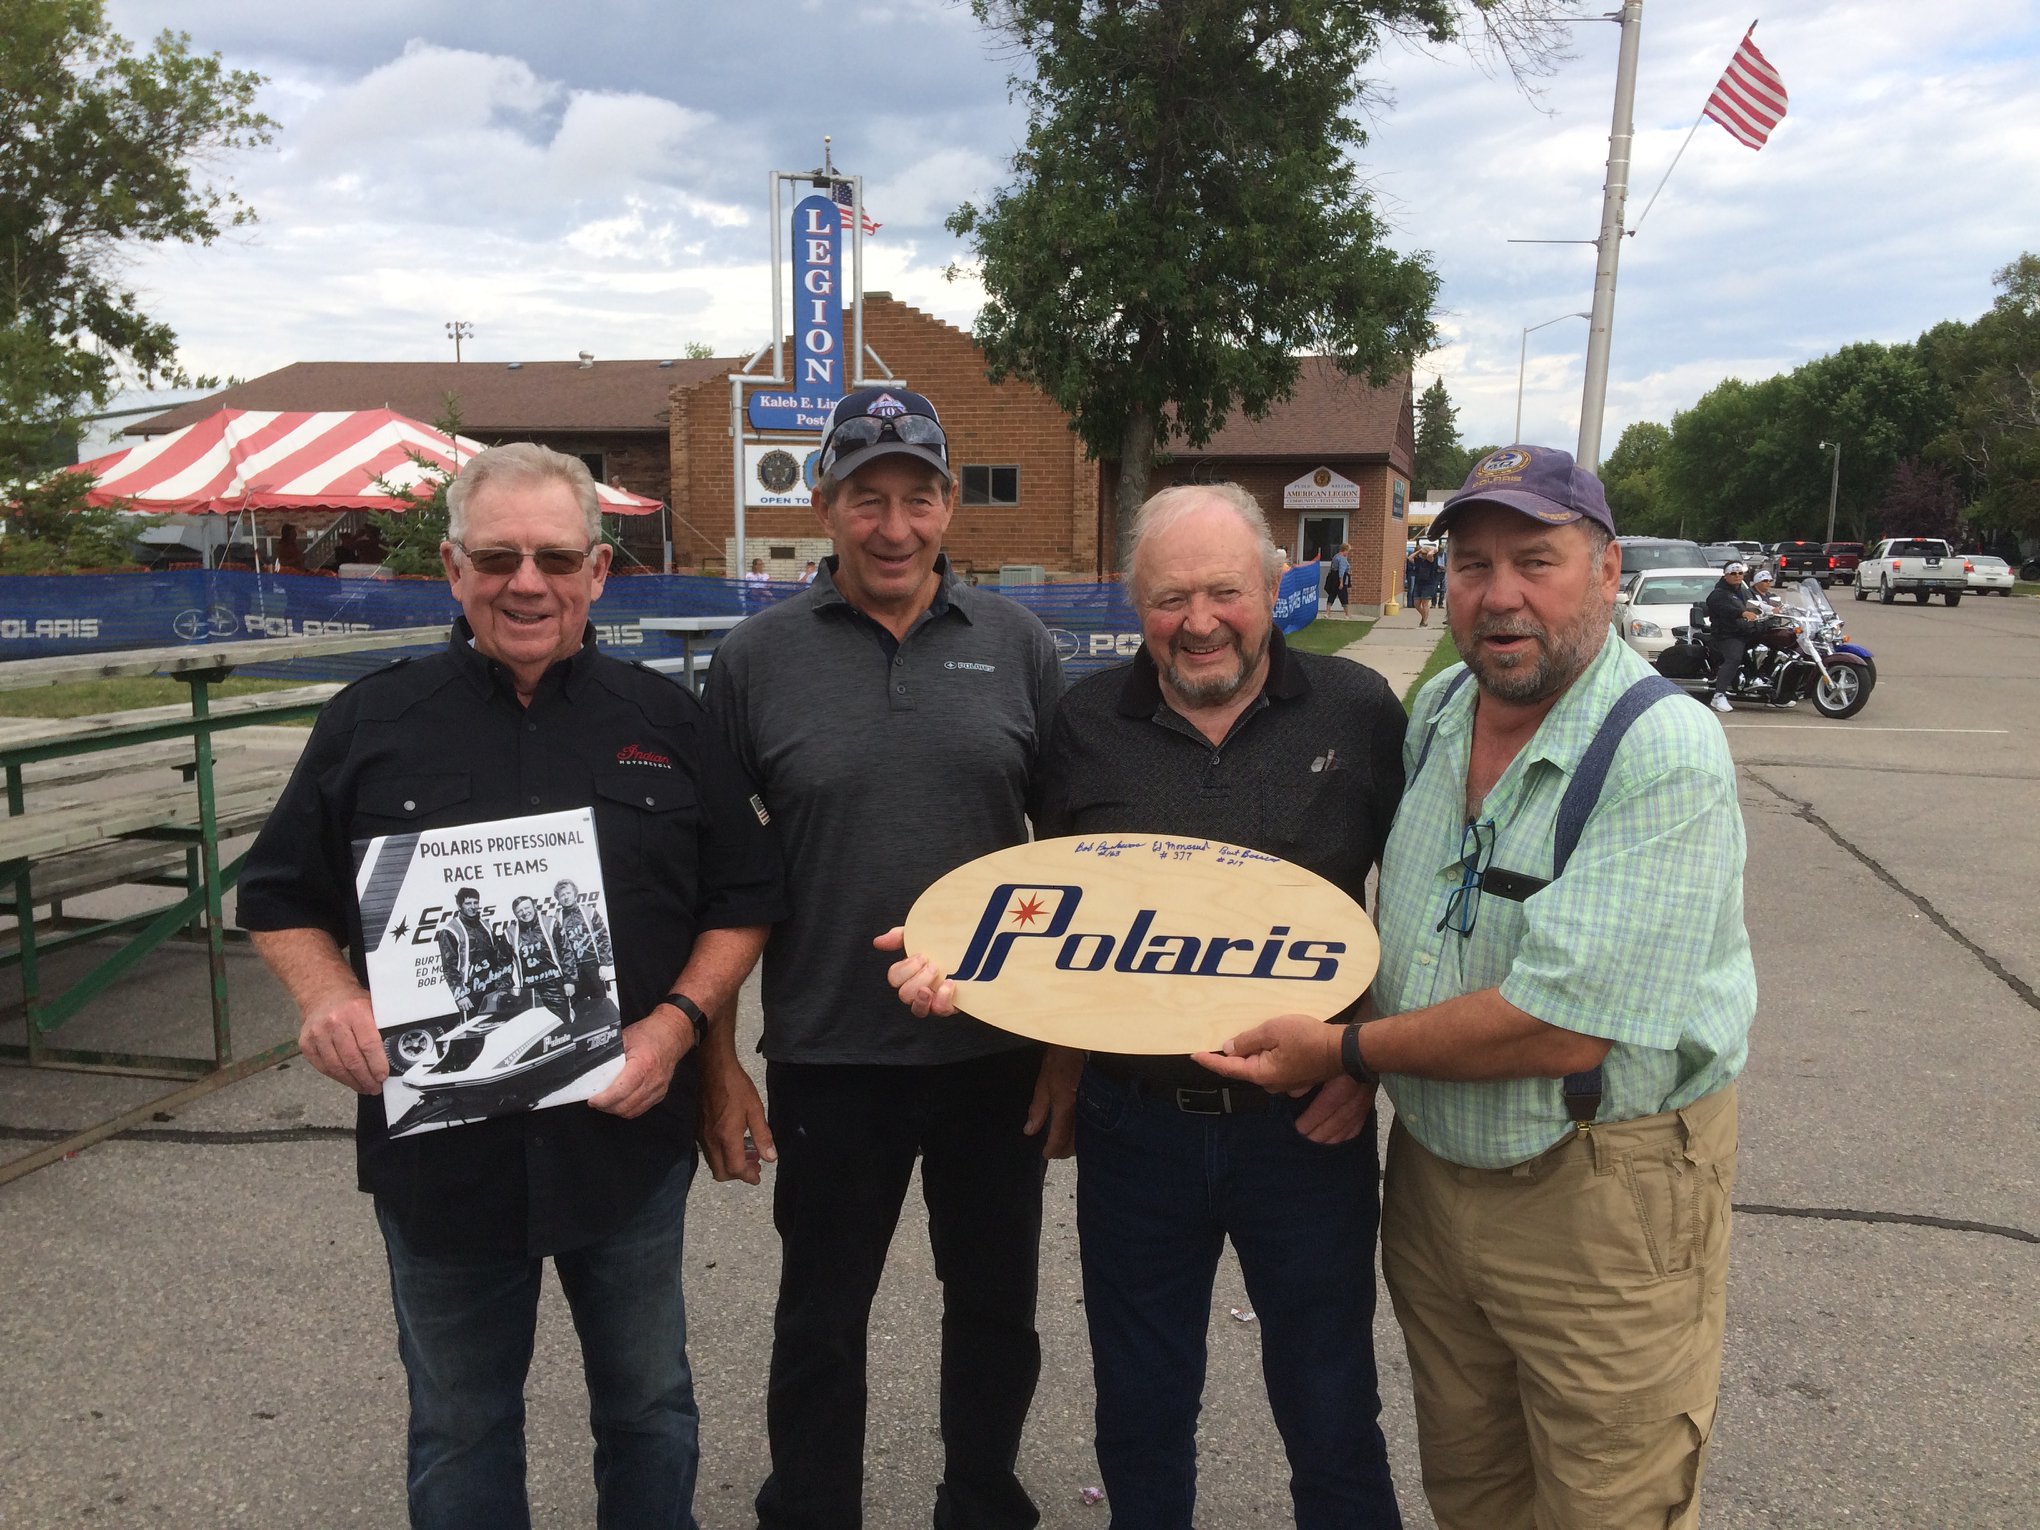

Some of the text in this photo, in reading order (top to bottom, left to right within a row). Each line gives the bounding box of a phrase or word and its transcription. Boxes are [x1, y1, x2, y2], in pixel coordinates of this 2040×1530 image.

[804, 208, 834, 384] LEGION
[760, 395, 798, 408] Kaleb
[801, 397, 813, 408] E.
[796, 413, 825, 425] Post
[616, 743, 670, 763] Indian
[420, 830, 584, 858] POLARIS PROFESSIONAL
[1152, 841, 1163, 852] Ed
[443, 858, 549, 883] RACE TEAMS
[946, 883, 1347, 982] Polaris
[415, 954, 441, 967] BURT
[416, 967, 429, 977] ED
[417, 976, 437, 988] BOB
